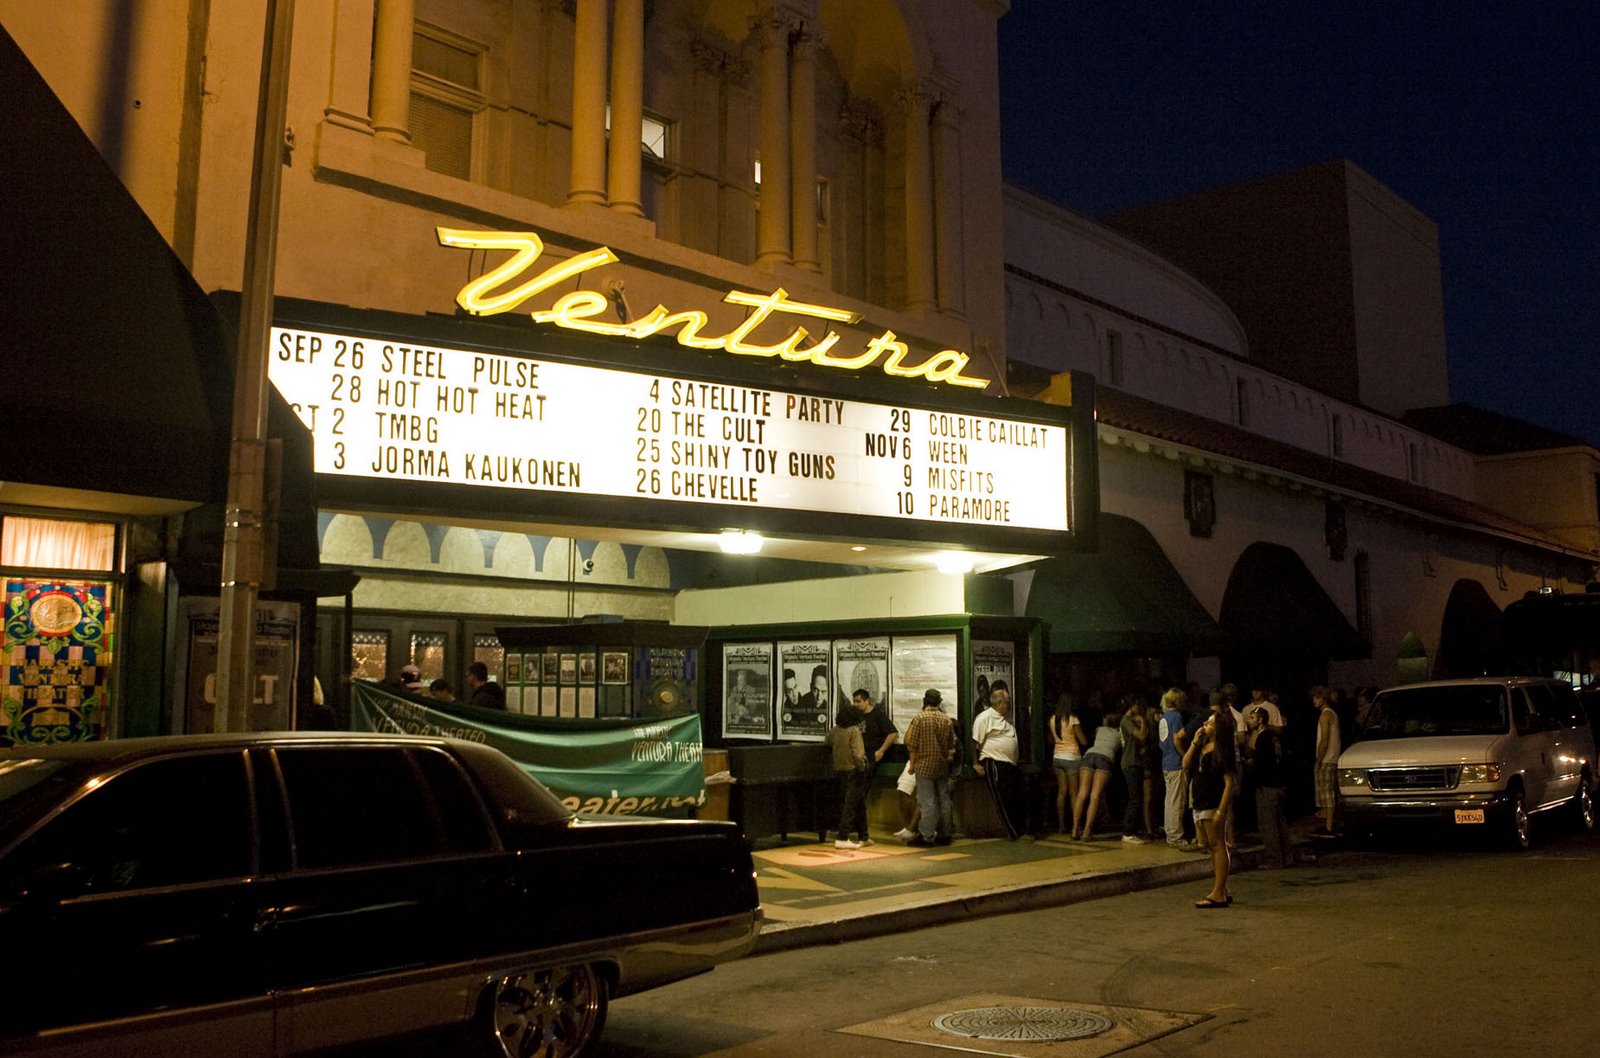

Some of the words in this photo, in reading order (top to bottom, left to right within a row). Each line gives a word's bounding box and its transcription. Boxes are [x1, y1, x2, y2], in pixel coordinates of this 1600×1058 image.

[436, 226, 991, 390] Ventura
[278, 332, 322, 364] SEP
[334, 340, 364, 369] 26
[381, 345, 447, 379] STEEL
[473, 356, 540, 389] PULSE
[331, 374, 361, 403] 28
[377, 379, 420, 409] HOT
[437, 387, 478, 415] HOT
[496, 391, 546, 421] HEAT
[649, 379, 659, 404] 4
[671, 380, 771, 417] SATELLITE
[786, 394, 844, 425] PARTY
[332, 408, 345, 435] 2
[375, 412, 438, 443] TMBG
[637, 408, 661, 433] 20
[671, 411, 705, 438] THE
[722, 415, 765, 445] CULT
[890, 408, 911, 433] 29
[929, 414, 983, 442] COLBIE
[988, 421, 1048, 449] CAILLAT
[333, 442, 345, 470] 3
[372, 445, 450, 478] JORMA
[465, 453, 580, 487] KAUKONEN
[637, 437, 660, 463] 25
[671, 441, 730, 471] SHINY
[743, 447, 777, 474] TOY
[788, 454, 835, 480] GUNS
[865, 432, 901, 460] NOV
[902, 435, 912, 460] 6
[928, 440, 967, 465] WEEN
[636, 469, 660, 494] 26
[671, 472, 758, 502] CHEVELLE
[904, 464, 912, 488] 9
[928, 467, 994, 494] MISFITS
[896, 491, 914, 515] 10
[929, 493, 1011, 522] PARAMORE
[632, 741, 672, 762] VENTURA
